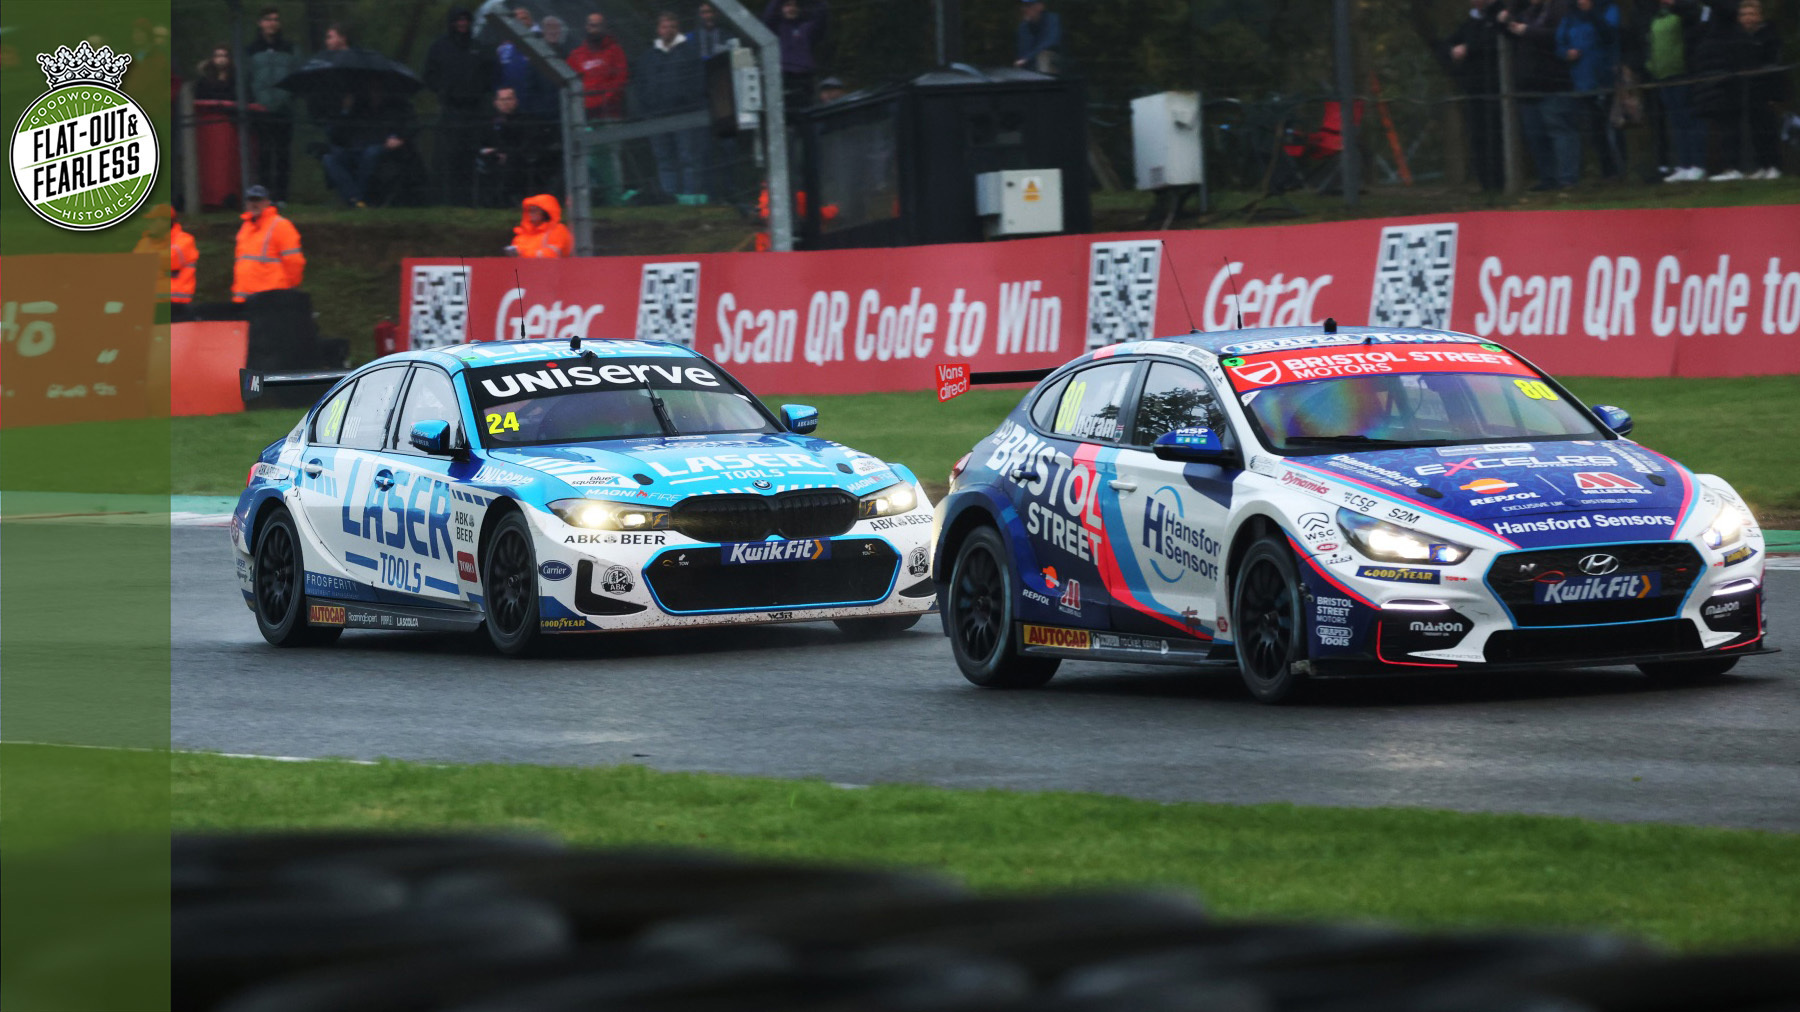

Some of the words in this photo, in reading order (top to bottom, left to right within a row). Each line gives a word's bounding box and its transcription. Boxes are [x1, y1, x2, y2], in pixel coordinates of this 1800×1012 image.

[1202, 261, 1334, 332] Getac
[1474, 255, 1573, 337] Scan
[1582, 254, 1641, 342] QR
[1651, 254, 1750, 338] Code
[1762, 256, 1800, 336] to
[713, 292, 798, 365] Scan
[804, 290, 850, 366] QR
[854, 286, 938, 363] Code
[944, 287, 987, 358] to
[996, 279, 1062, 355] Win
[1239, 334, 1357, 351] DRAPER
[1281, 351, 1406, 371] BRISTOL
[1408, 351, 1515, 366] STREET
[938, 365, 963, 382] Vans
[1291, 362, 1393, 379] MOTORS
[939, 378, 967, 400] direct
[1513, 379, 1559, 401] 80
[1055, 380, 1086, 431] 80
[323, 398, 346, 438] 24
[486, 411, 520, 435] 24
[1176, 427, 1208, 435] MSP
[647, 452, 827, 478] LASER
[1331, 454, 1423, 488] Diamondbrite
[720, 468, 785, 481] TOOLS
[985, 423, 1103, 530] BRISTOL
[1281, 471, 1331, 495] Dynamics
[585, 489, 637, 498] MAGNI
[648, 492, 683, 503] FIRE
[1349, 494, 1378, 513] csg
[1470, 490, 1542, 507] REPSOL
[1502, 502, 1550, 512] EXCLUSIVE
[1580, 498, 1638, 506] DISTRIBUTOR
[342, 457, 454, 564] LASER
[455, 511, 469, 527] ABK
[1388, 507, 1421, 525] S2M
[869, 517, 899, 532] ABK
[1026, 501, 1103, 566] STREET
[1143, 495, 1166, 556] H
[1165, 509, 1222, 557] Hansfor
[1493, 515, 1597, 536] Hansford
[1598, 513, 1676, 528] Sensors
[456, 527, 473, 544] BEER
[564, 534, 602, 544] ABK
[621, 534, 667, 546] BEER
[1305, 529, 1336, 541] WSC
[380, 551, 422, 594] TOOLS
[542, 565, 567, 575] Carrier
[1364, 567, 1433, 581] GOODYEAR
[610, 584, 626, 592] ABK
[1022, 588, 1050, 606] REPSOL
[1316, 596, 1354, 608] BRISTOL
[310, 606, 346, 624] AUTOCAR
[1316, 606, 1350, 617] STREET
[1316, 615, 1347, 624] MOTORS
[1029, 626, 1088, 648] AUTOCAR
[1318, 627, 1350, 637] DRAPER
[1321, 636, 1350, 647] Tools
